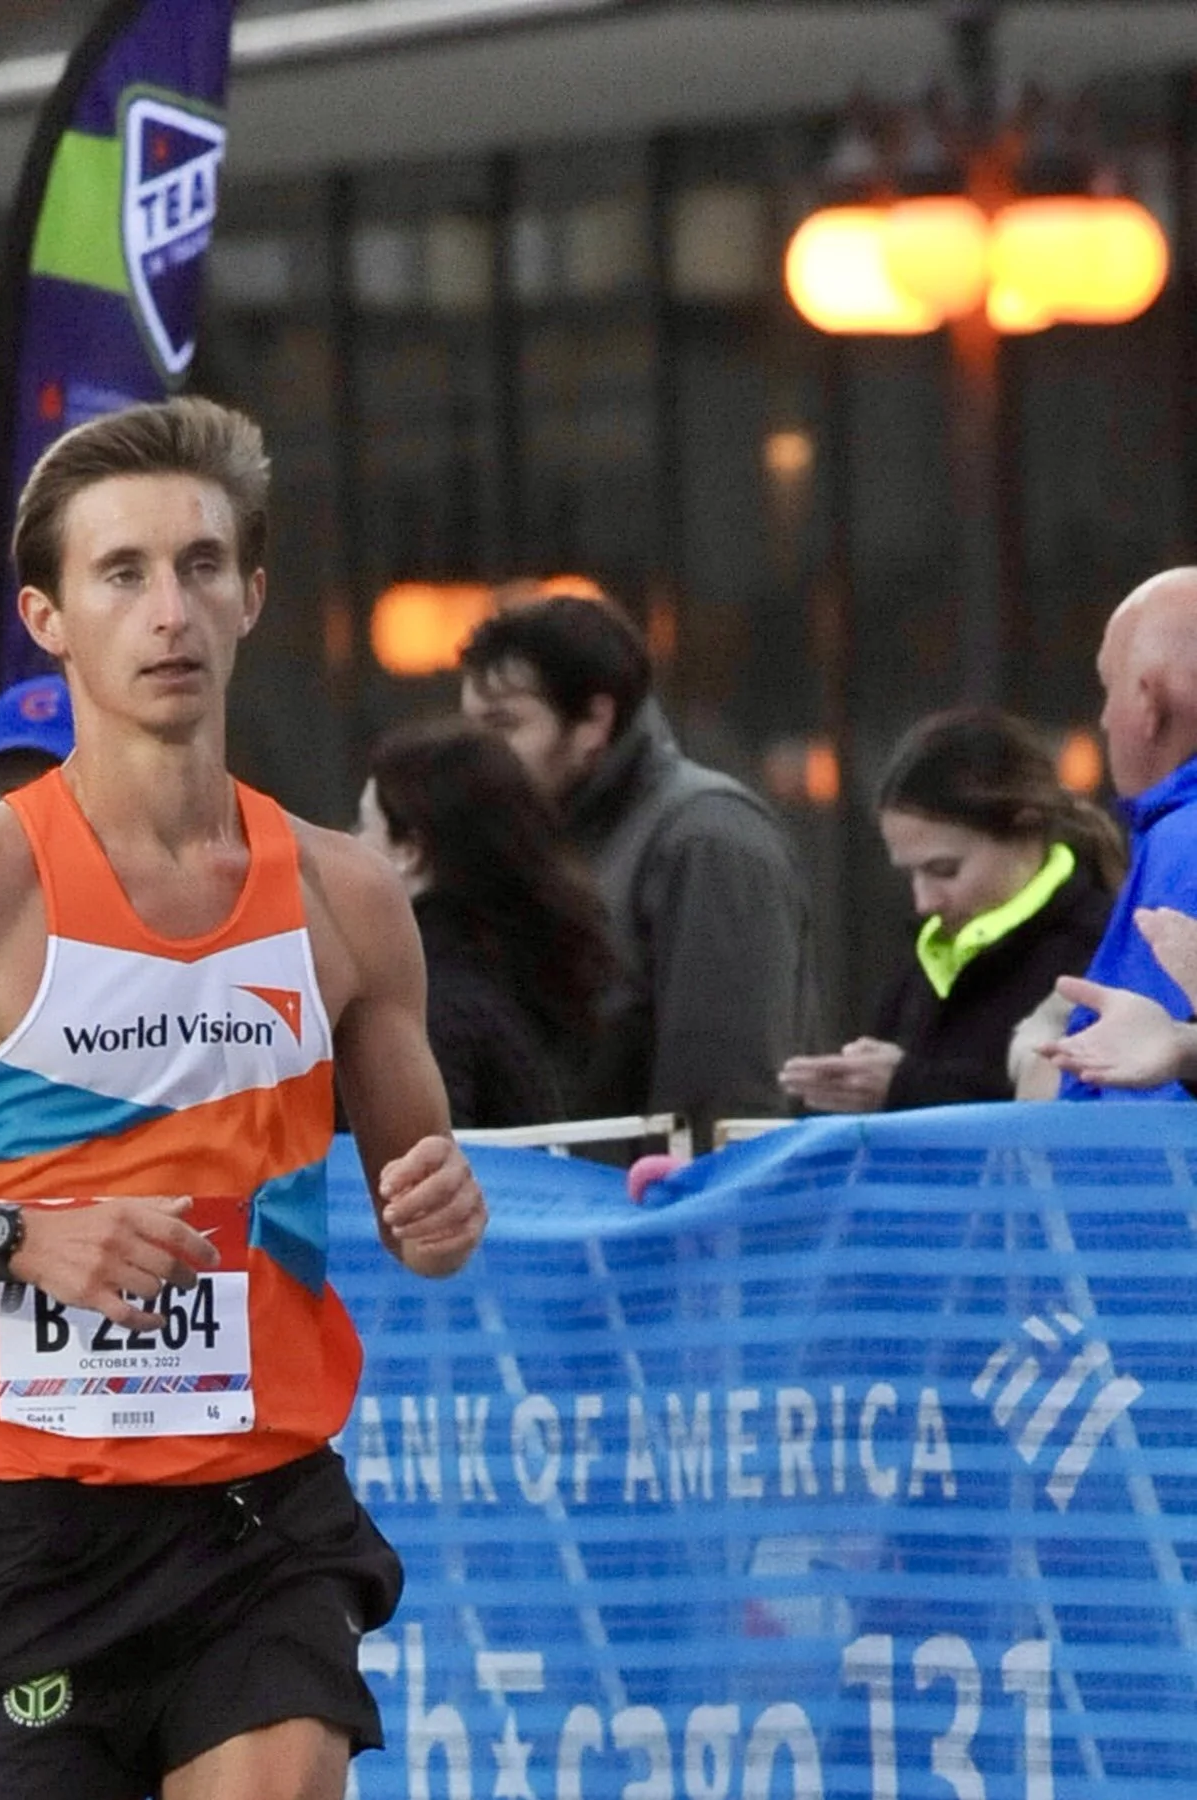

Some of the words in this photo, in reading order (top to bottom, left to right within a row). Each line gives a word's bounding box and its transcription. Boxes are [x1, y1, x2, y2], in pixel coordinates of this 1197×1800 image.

[63, 1013, 168, 1054] World
[176, 1011, 276, 1046] Vision
[79, 1357, 138, 1369] OCTOBER
[154, 1356, 181, 1368] 2022
[330, 1395, 498, 1503] ANK
[511, 1394, 602, 1504] OF
[623, 1382, 957, 1503] AMERICA
